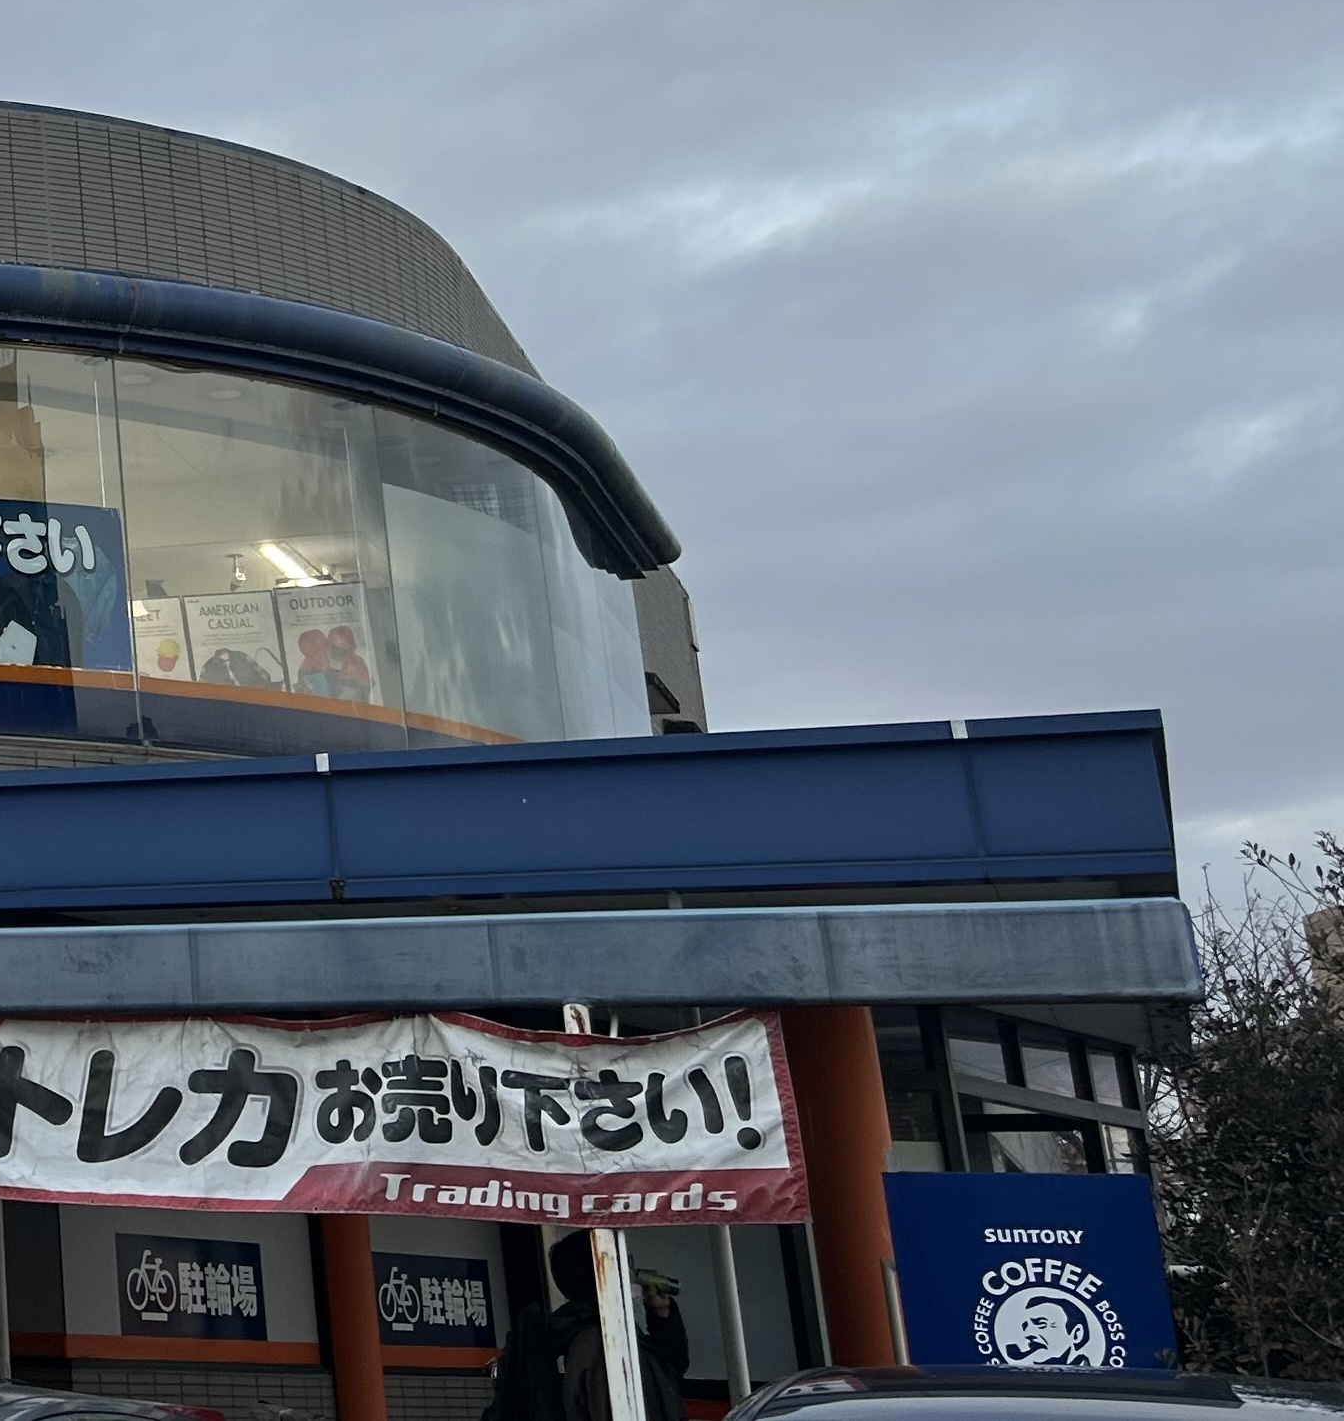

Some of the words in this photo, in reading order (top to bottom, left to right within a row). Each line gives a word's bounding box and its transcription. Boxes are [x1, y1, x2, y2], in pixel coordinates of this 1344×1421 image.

[199, 602, 260, 617] AMERICAN
[290, 595, 355, 610] OUTDOOR
[208, 618, 255, 630] CASUAL
[315, 1054, 764, 1153] お売り下さい!
[379, 1172, 570, 1219] Trading
[581, 1183, 738, 1214] cards
[984, 1228, 1084, 1245] SUNTORY
[178, 1262, 258, 1319] 駐輪場
[982, 1258, 1103, 1300] COFFEE
[421, 1277, 488, 1328] 駐輪場
[1095, 1300, 1126, 1341] BOSS
[974, 1297, 995, 1355] COFFEE
